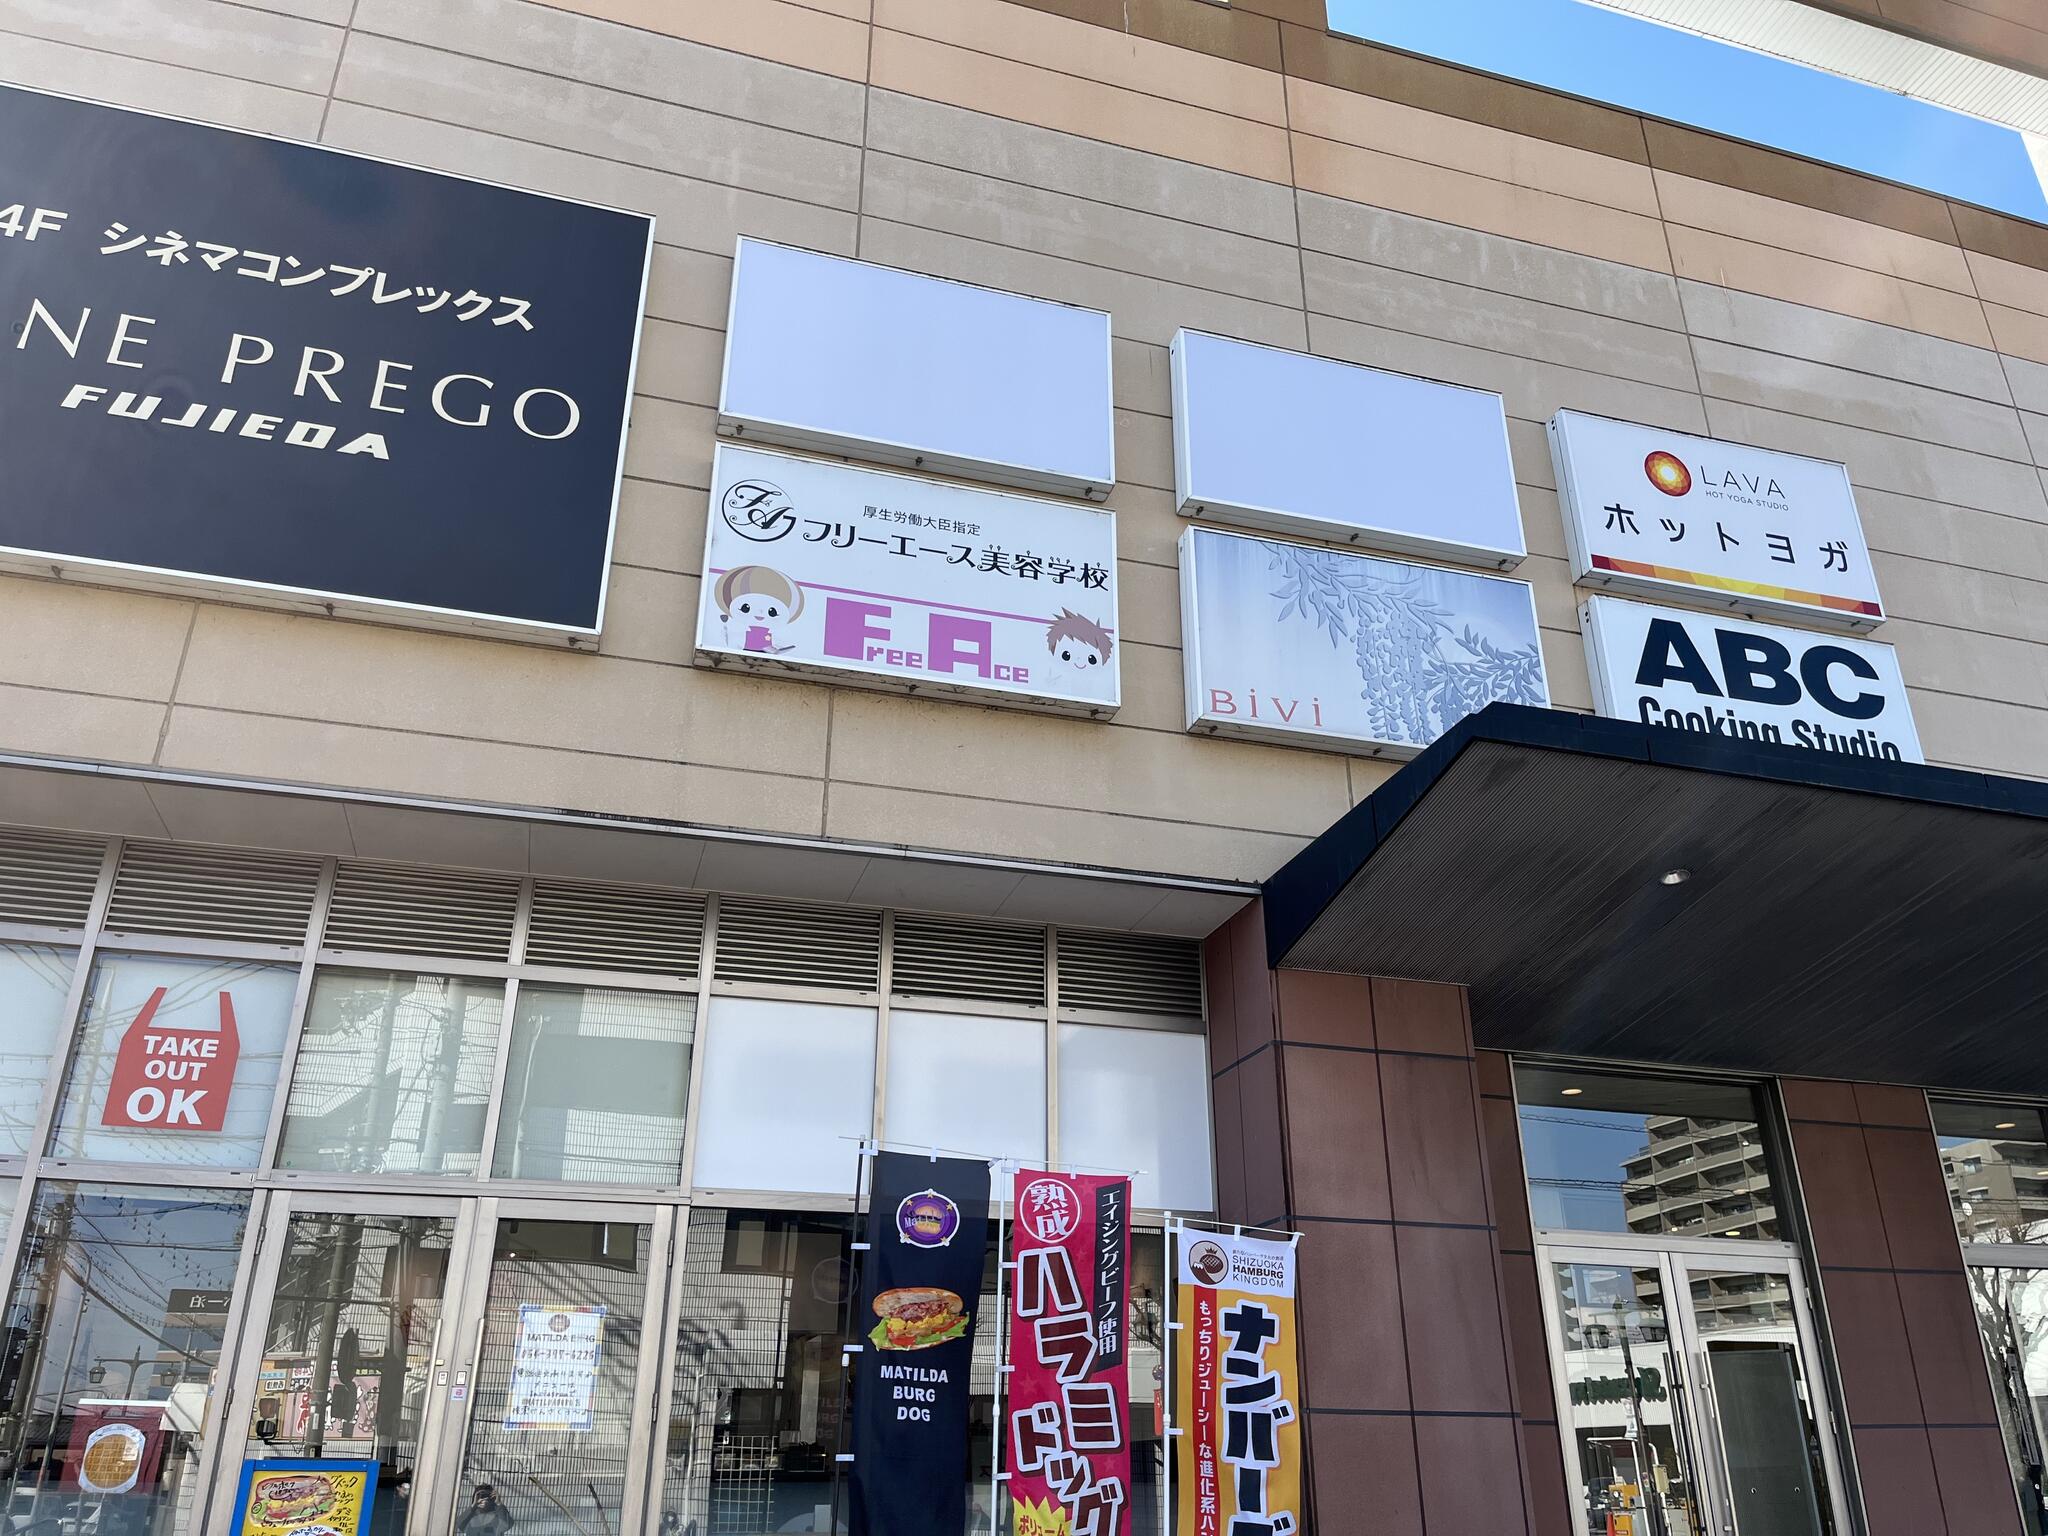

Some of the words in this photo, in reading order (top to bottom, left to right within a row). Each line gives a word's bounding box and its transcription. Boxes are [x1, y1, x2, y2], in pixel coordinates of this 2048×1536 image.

[0, 204, 68, 241] 4F
[100, 221, 535, 332] シネマコンプレックス
[221, 331, 581, 441] PREGO
[61, 384, 391, 460] FUJIEDA
[1700, 465, 1786, 499] LAVA
[1705, 490, 1724, 499] HOT
[1727, 493, 1754, 505] YOGA
[1756, 499, 1789, 512] STUDIO
[862, 505, 982, 537] 厚生労働大臣指定
[1603, 503, 1849, 573] ホットヨガ
[802, 519, 1110, 592] フリーエース美容学校
[823, 597, 923, 670] Free
[928, 613, 1030, 684] Ace
[1634, 618, 1886, 720] ABC
[143, 1034, 219, 1058] TAKE
[144, 1060, 208, 1081] OUT
[126, 1087, 209, 1125] OK
[1029, 1182, 1070, 1239] 熟成
[1098, 1188, 1122, 1355] エイジングビーフ使用
[1232, 1255, 1284, 1270] SHIZUOKA
[1232, 1264, 1284, 1279] HAMBURG
[1232, 1273, 1284, 1288] KINGDOM
[527, 1333, 568, 1343] MATILDA
[880, 1365, 949, 1384] MATILDA
[892, 1385, 936, 1403] BURG
[896, 1404, 932, 1422] DOG
